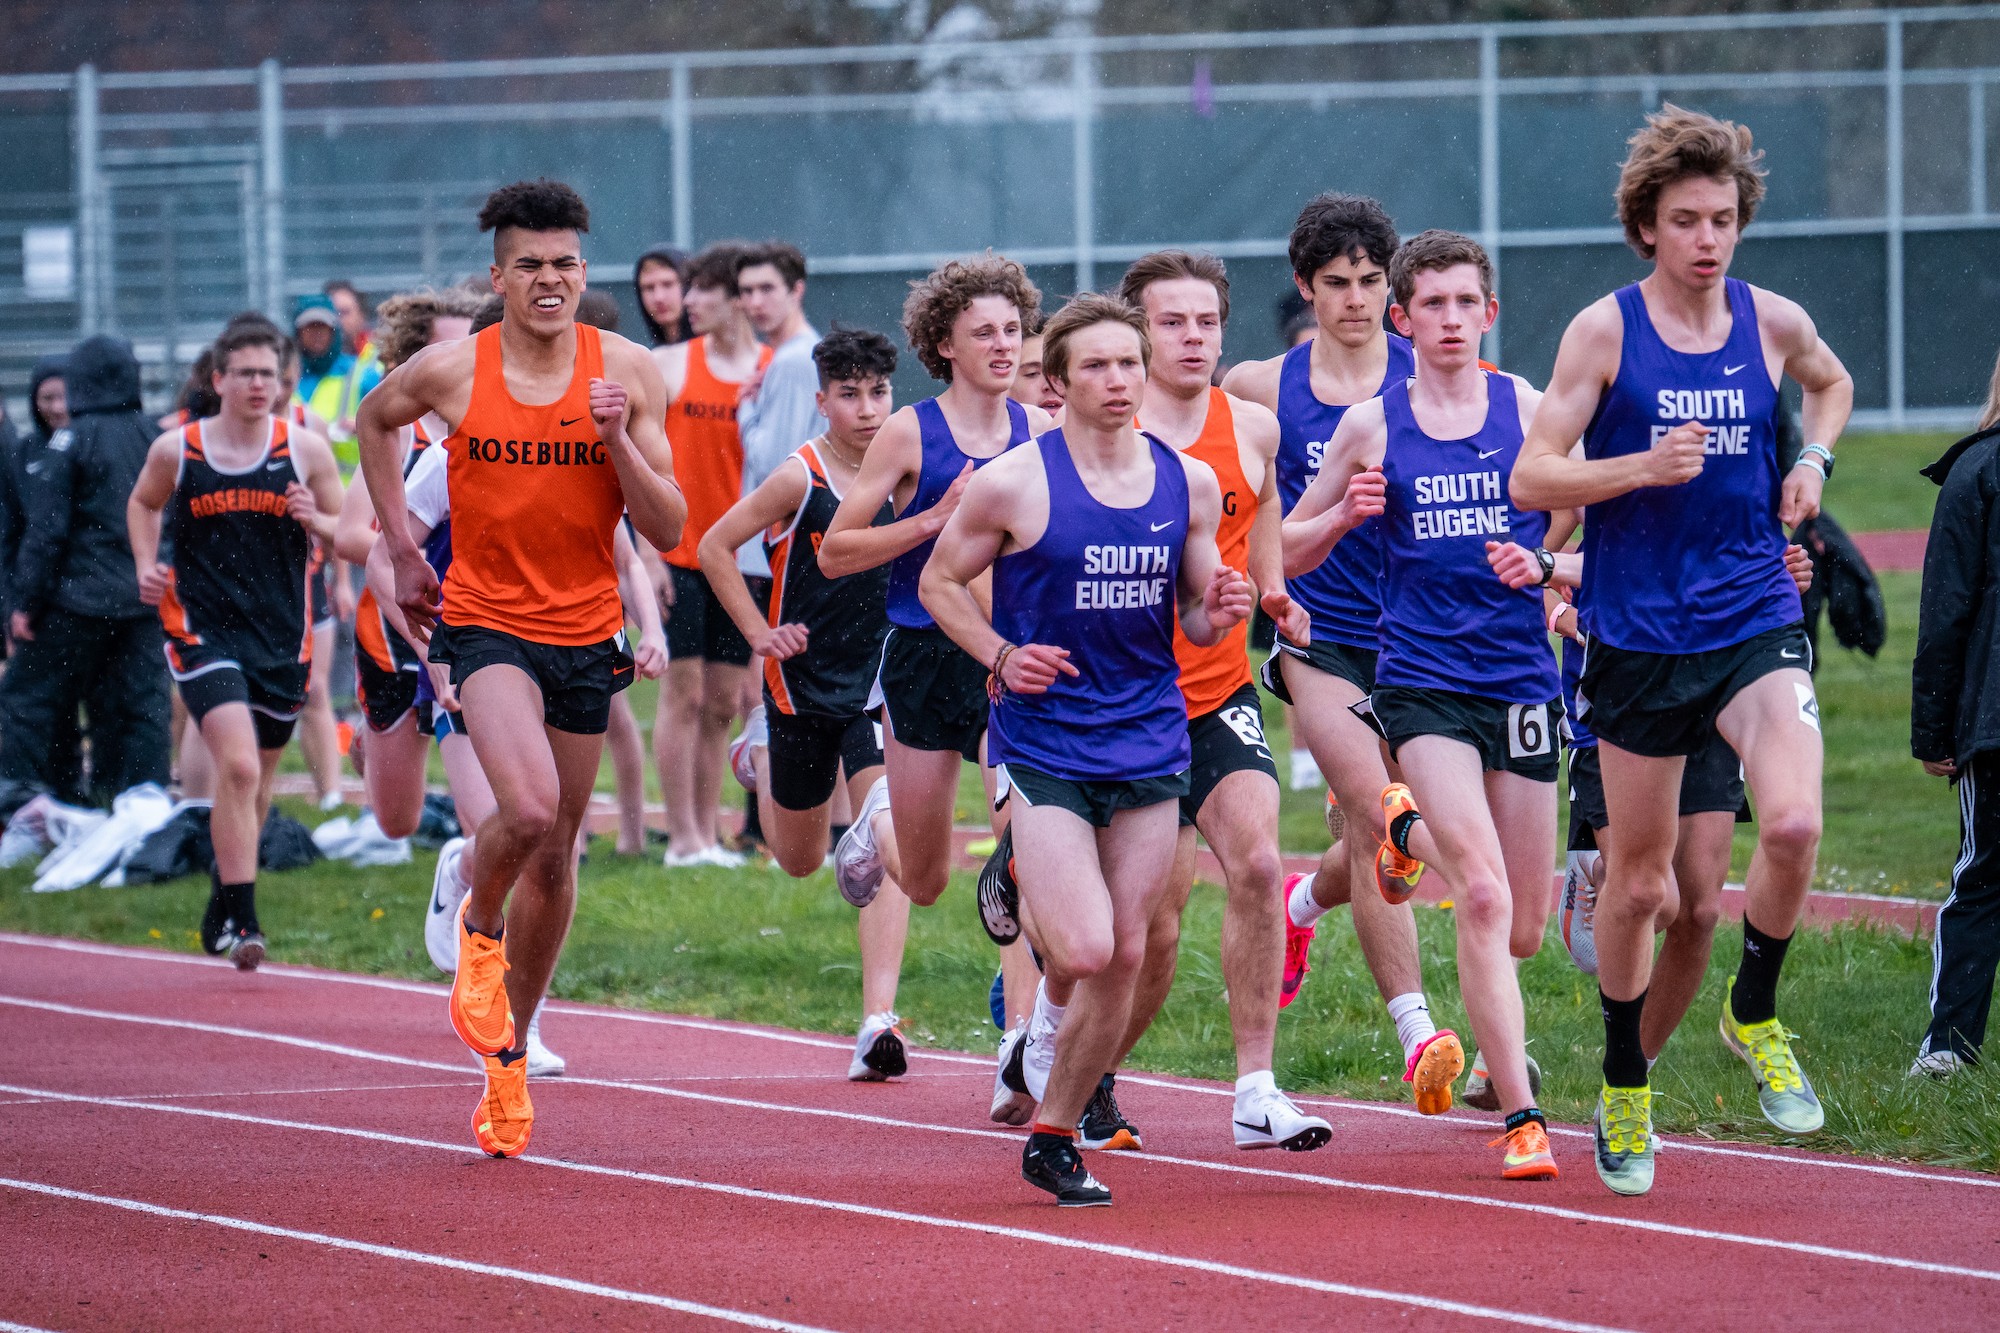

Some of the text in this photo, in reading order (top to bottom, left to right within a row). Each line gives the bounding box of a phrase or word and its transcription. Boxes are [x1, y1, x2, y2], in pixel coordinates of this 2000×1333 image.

[1658, 389, 1746, 420] SOUTH
[468, 436, 606, 466] ROSEBURG
[1650, 425, 1751, 455] EENE
[189, 488, 288, 519] ROSEBURG
[1414, 471, 1501, 505] SOUTH
[1412, 505, 1510, 541] EUGENE
[1084, 545, 1170, 575] SOUTH
[1075, 578, 1169, 610] EUGENE
[1230, 709, 1265, 743] 3
[1518, 704, 1542, 753] 6
